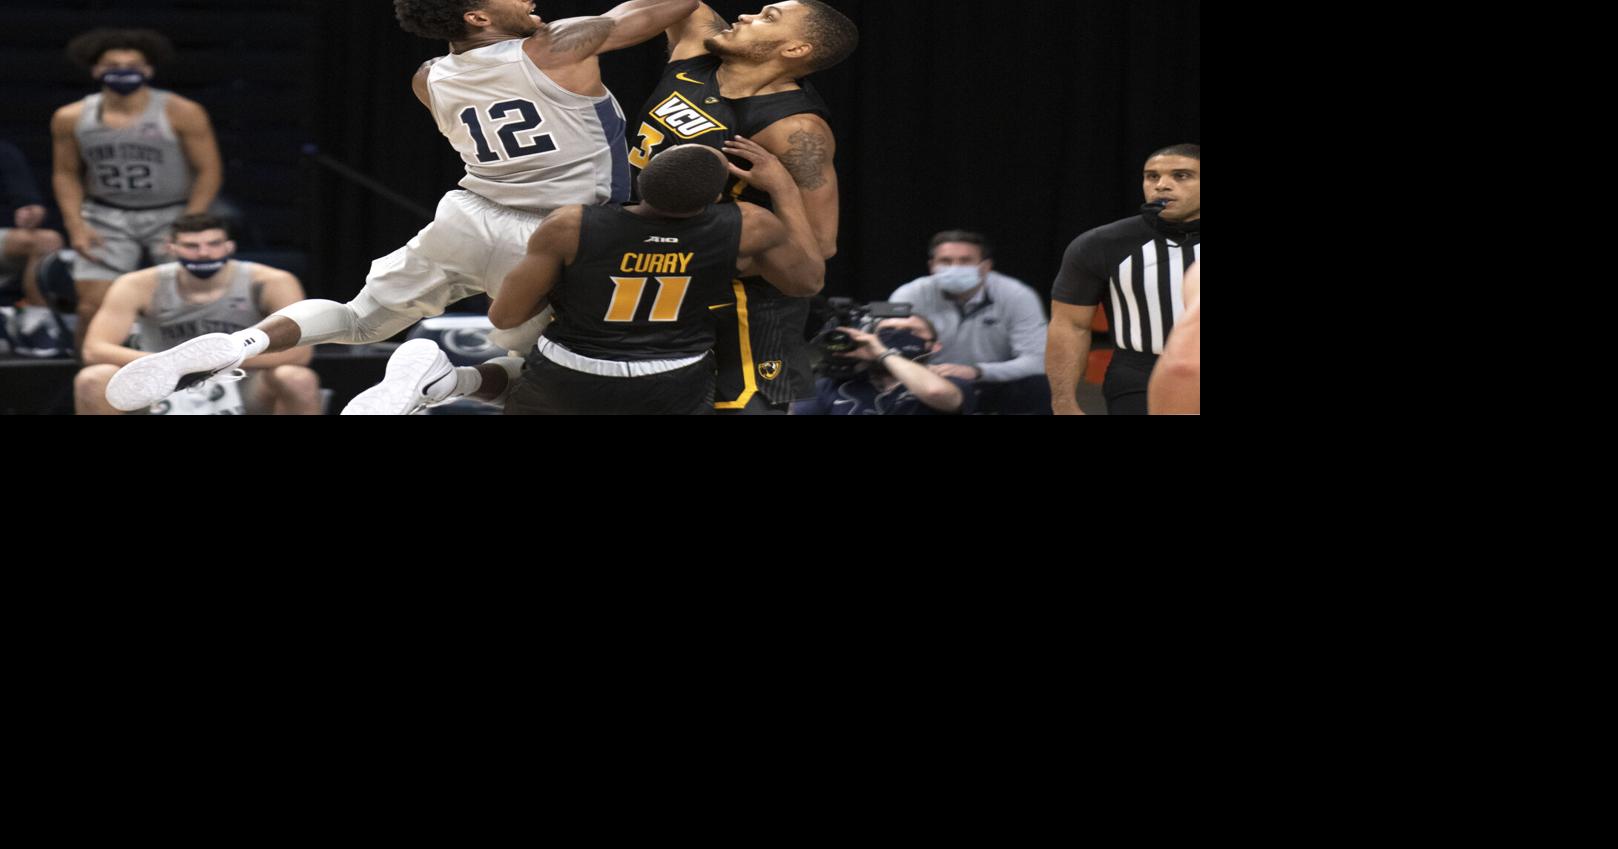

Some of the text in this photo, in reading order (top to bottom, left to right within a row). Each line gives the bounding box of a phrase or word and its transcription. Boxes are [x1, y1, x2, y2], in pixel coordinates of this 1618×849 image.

[458, 97, 560, 164] 12
[654, 96, 717, 136] VCU
[628, 121, 665, 169] 3
[97, 164, 152, 189] 22
[620, 252, 695, 273] CURRY
[603, 276, 692, 322] 11
